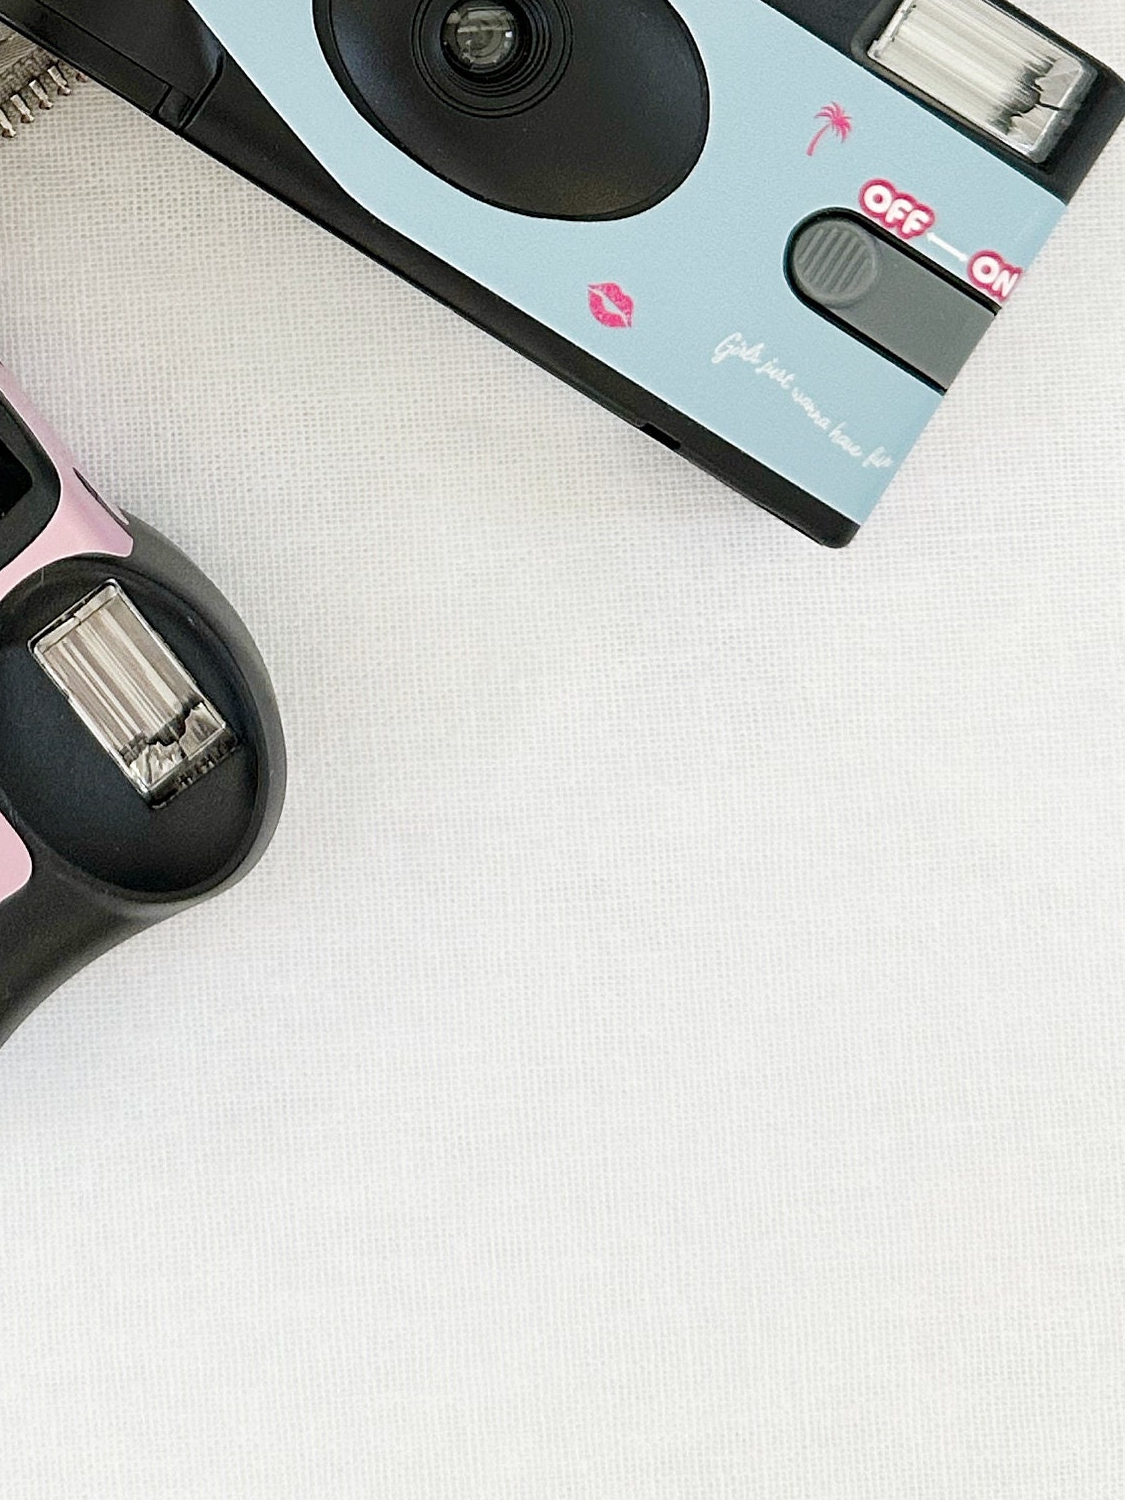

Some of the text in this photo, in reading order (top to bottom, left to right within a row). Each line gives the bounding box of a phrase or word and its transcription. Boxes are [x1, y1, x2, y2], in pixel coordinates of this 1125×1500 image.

[861, 180, 934, 238] OFF
[969, 252, 1021, 300] ON
[711, 331, 765, 364] Girls
[754, 357, 796, 390] just
[791, 386, 832, 431] wanna
[828, 421, 864, 457] have
